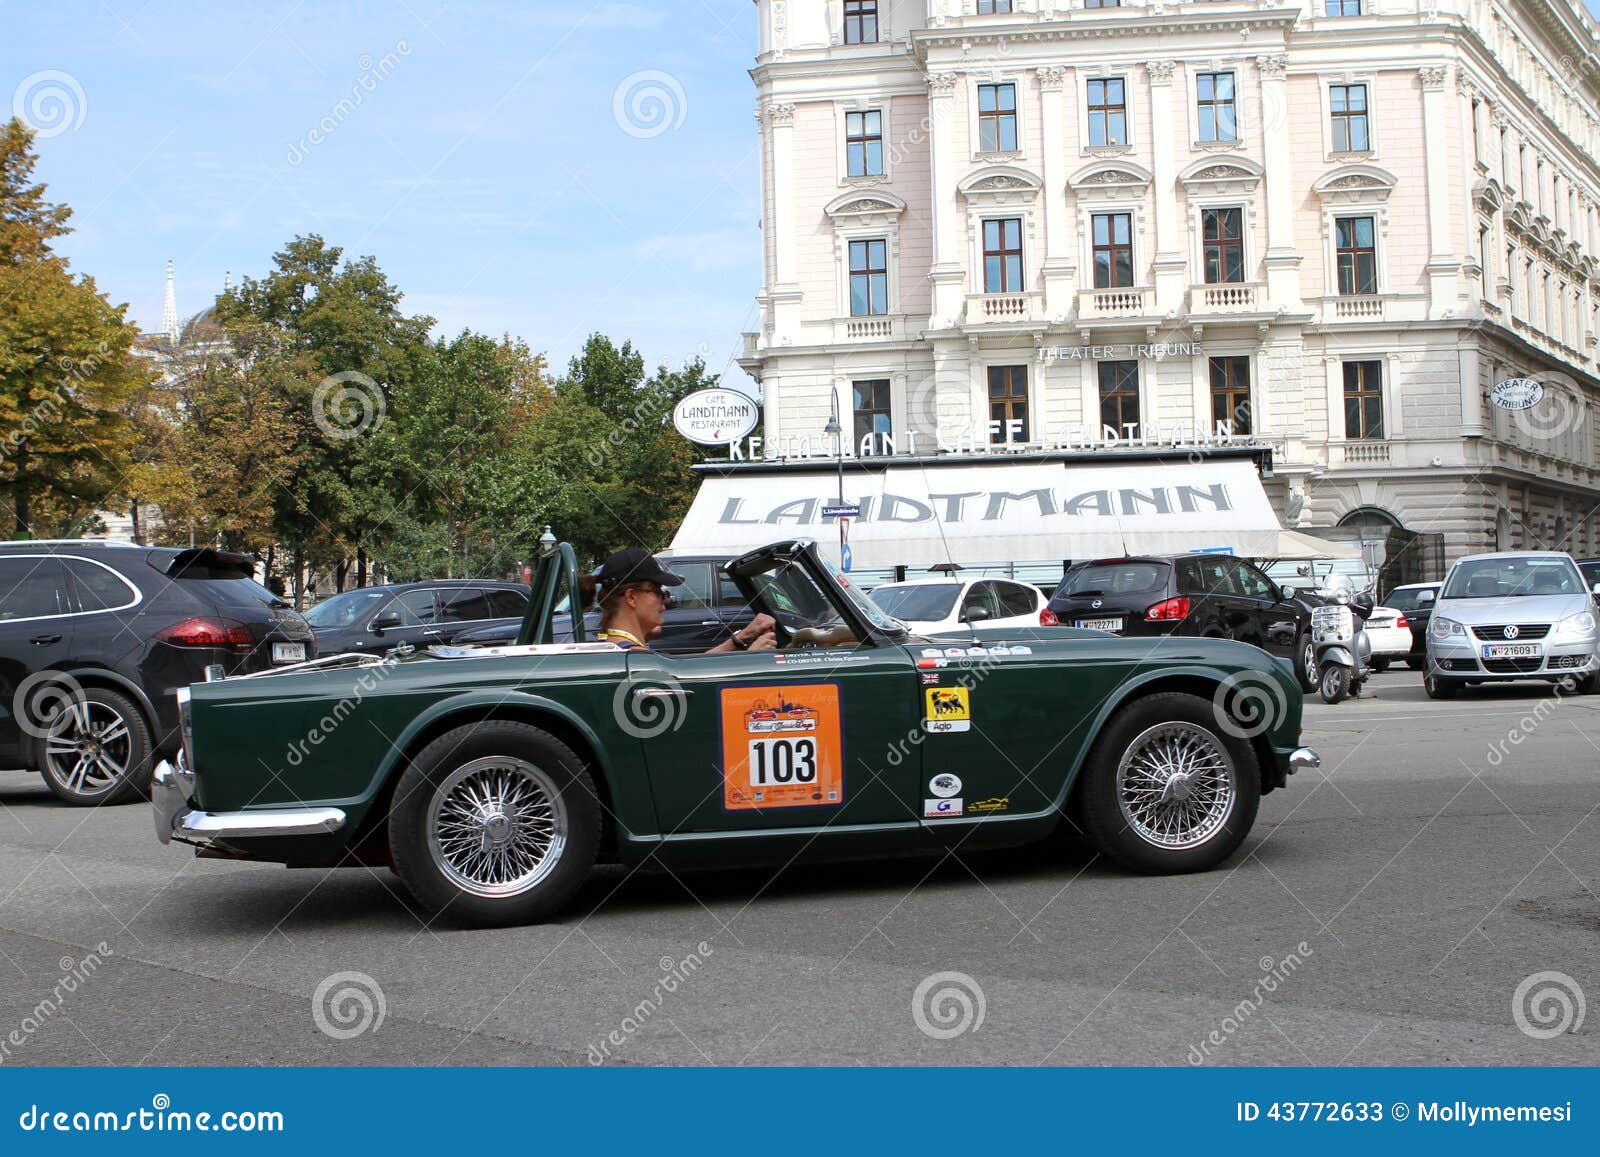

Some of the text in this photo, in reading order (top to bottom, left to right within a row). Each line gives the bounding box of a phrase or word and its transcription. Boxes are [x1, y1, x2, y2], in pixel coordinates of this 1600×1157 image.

[1038, 342, 1202, 360] THEATER TRIBUNE
[1492, 379, 1539, 396] THEATER
[705, 395, 726, 404] CAFE
[1496, 394, 1539, 409] TRIBUNE
[682, 405, 750, 419] LANDTMANN
[690, 419, 742, 429] RESTAURANT
[936, 418, 1024, 453] CAFE
[1040, 418, 1233, 449] LANDTMANN
[717, 483, 1235, 525] LANDTMANN
[933, 722, 952, 731] Agip
[753, 739, 815, 784] 103
